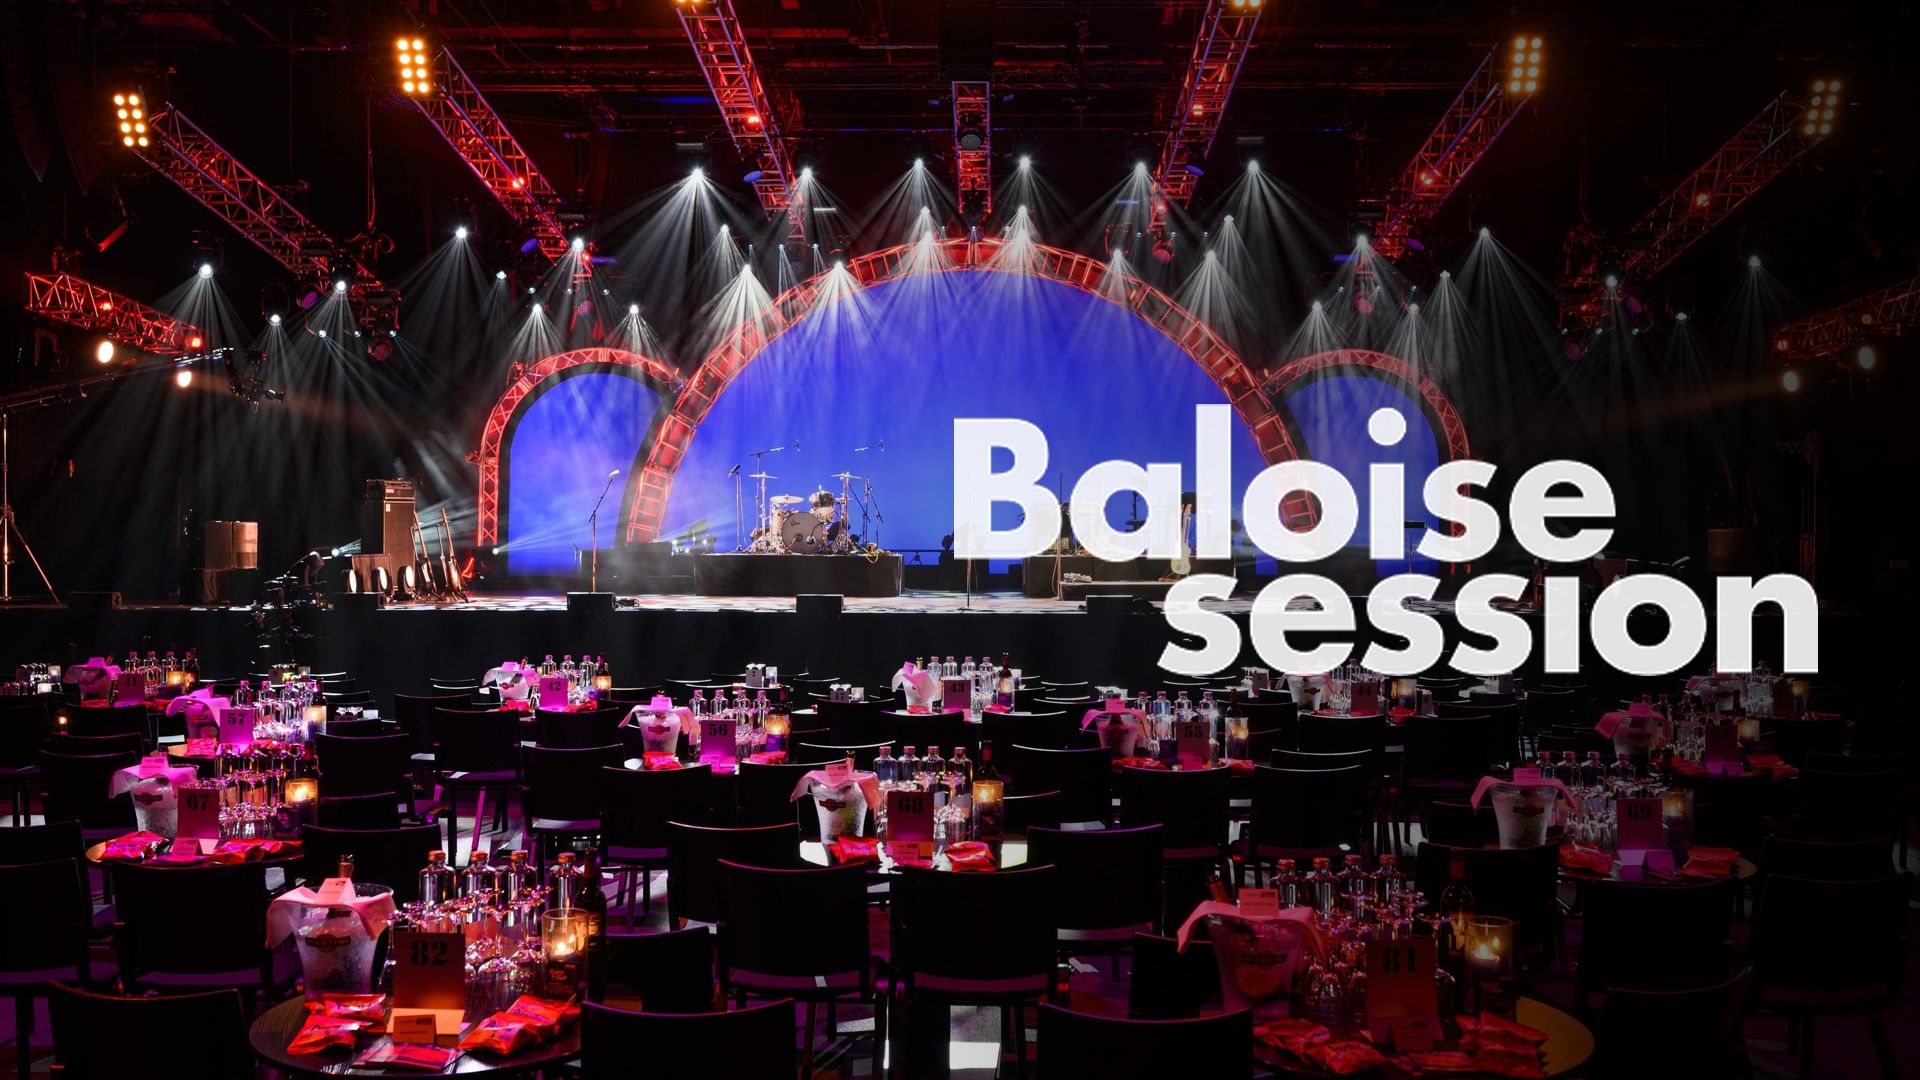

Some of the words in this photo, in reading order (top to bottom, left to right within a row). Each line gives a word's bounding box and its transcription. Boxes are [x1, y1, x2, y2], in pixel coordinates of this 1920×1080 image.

[546, 680, 562, 691] 42
[949, 682, 965, 693] 43
[227, 712, 246, 726] 57
[708, 723, 728, 736] 56
[1184, 725, 1203, 739] 55
[187, 793, 209, 811] 67
[898, 796, 924, 814] 68
[1627, 804, 1653, 821] 69
[306, 937, 350, 947] MARTINI
[410, 940, 448, 966] 82
[1383, 946, 1418, 974] 81
